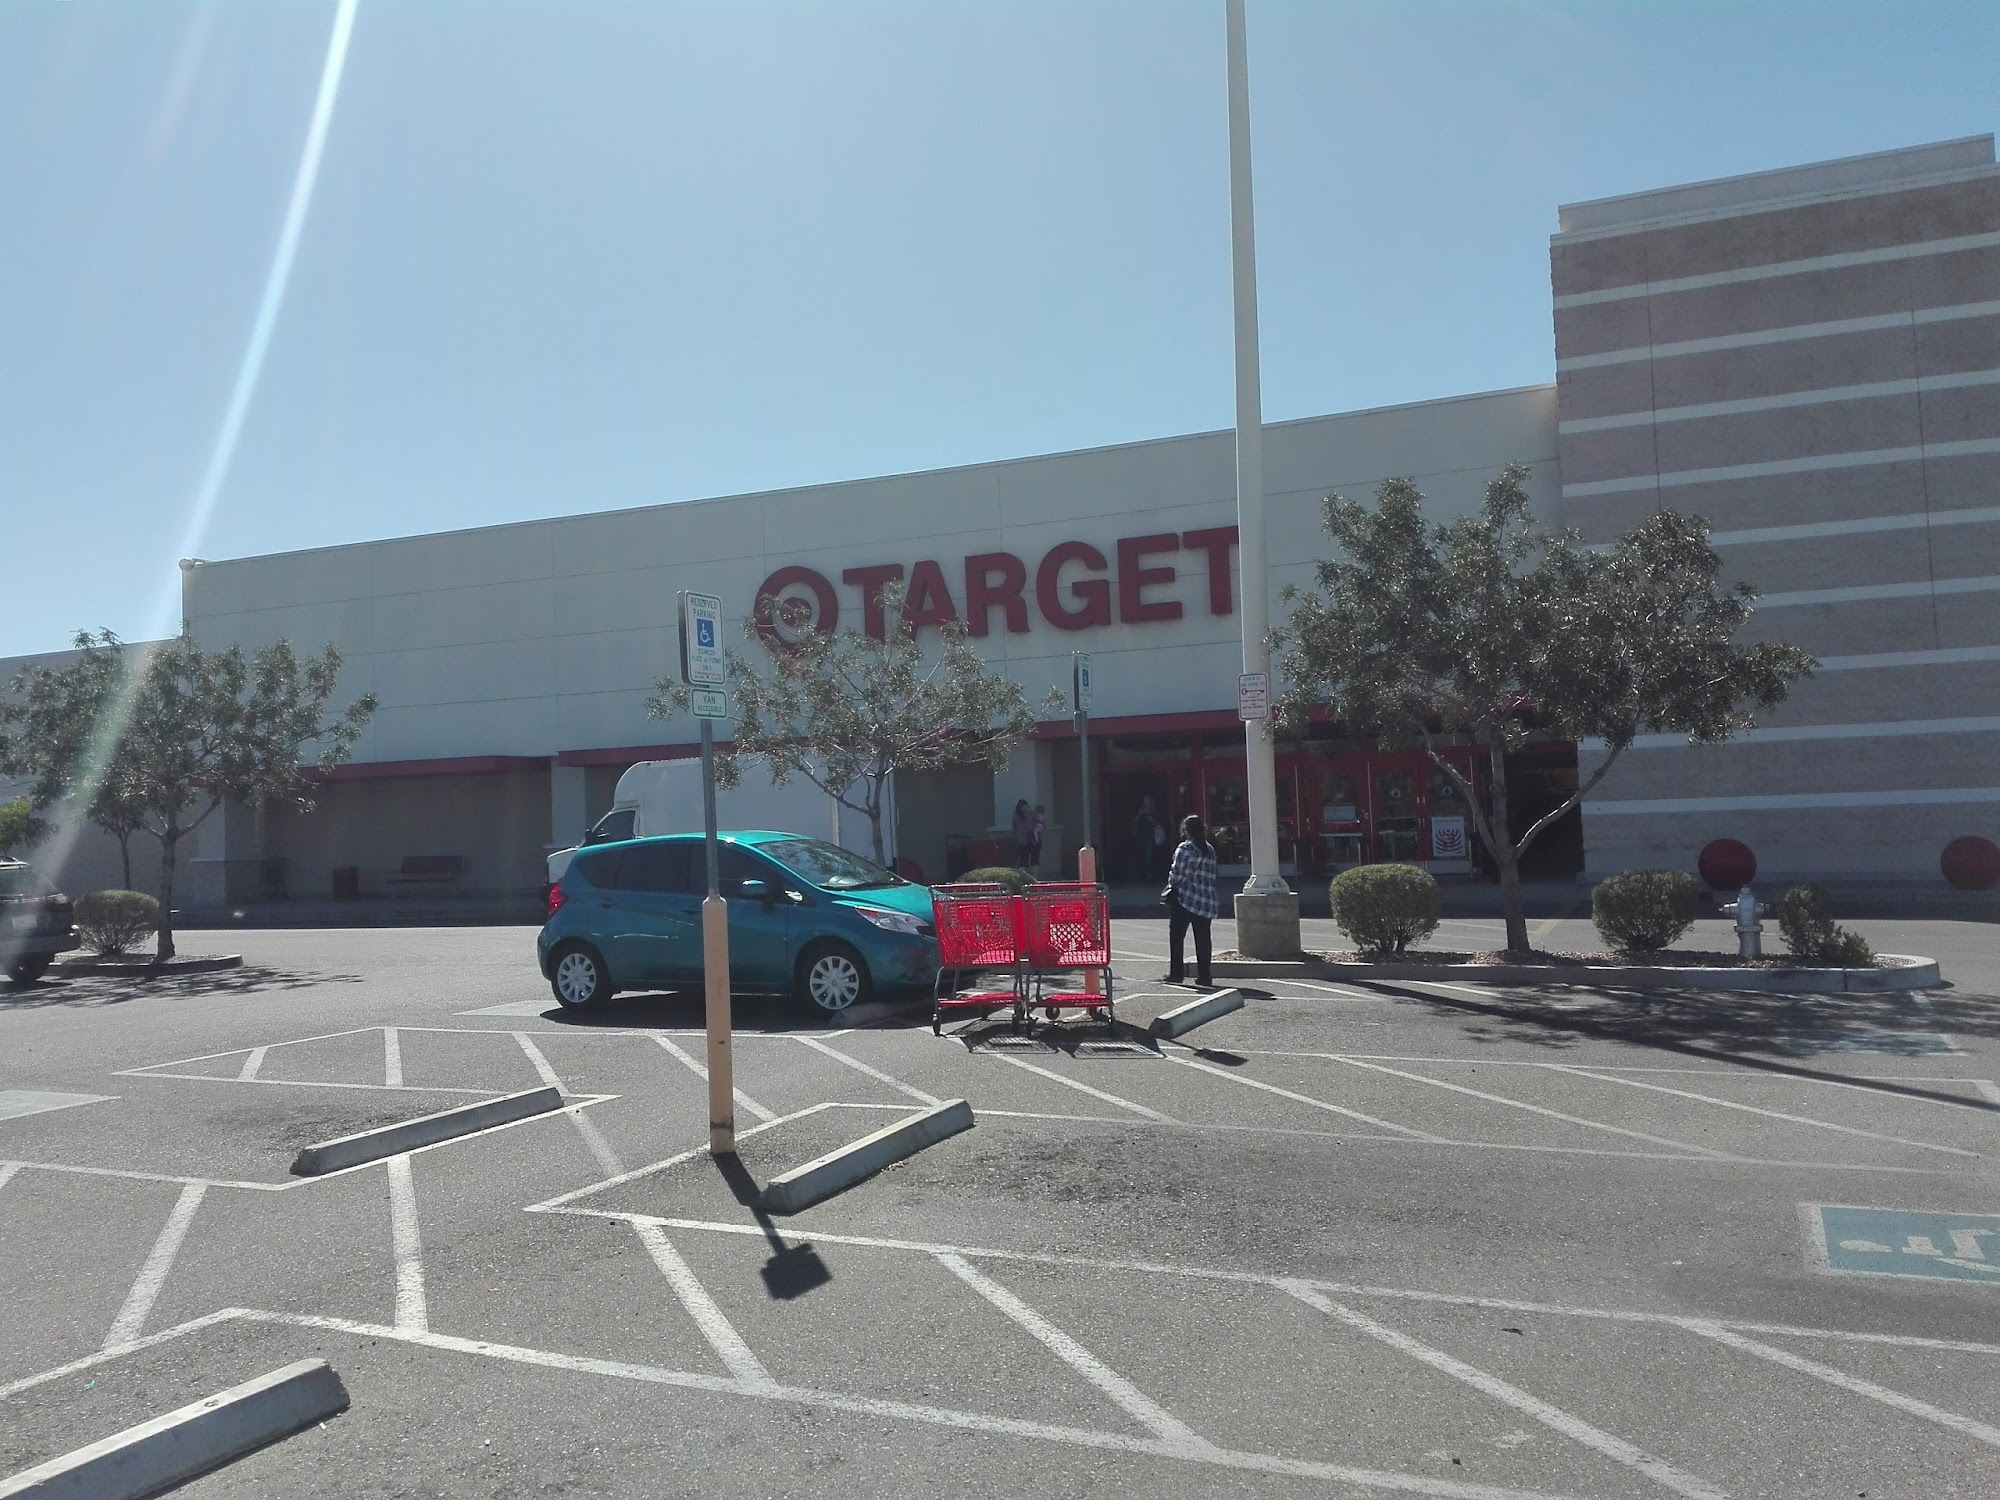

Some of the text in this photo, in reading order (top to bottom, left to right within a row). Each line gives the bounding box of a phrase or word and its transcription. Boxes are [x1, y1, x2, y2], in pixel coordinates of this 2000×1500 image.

[842, 524, 1239, 645] TARGET
[690, 597, 717, 609] RESERVED
[693, 608, 716, 620] PARKING
[703, 694, 716, 705] VAN
[697, 704, 722, 713] ACCESSIBLE
